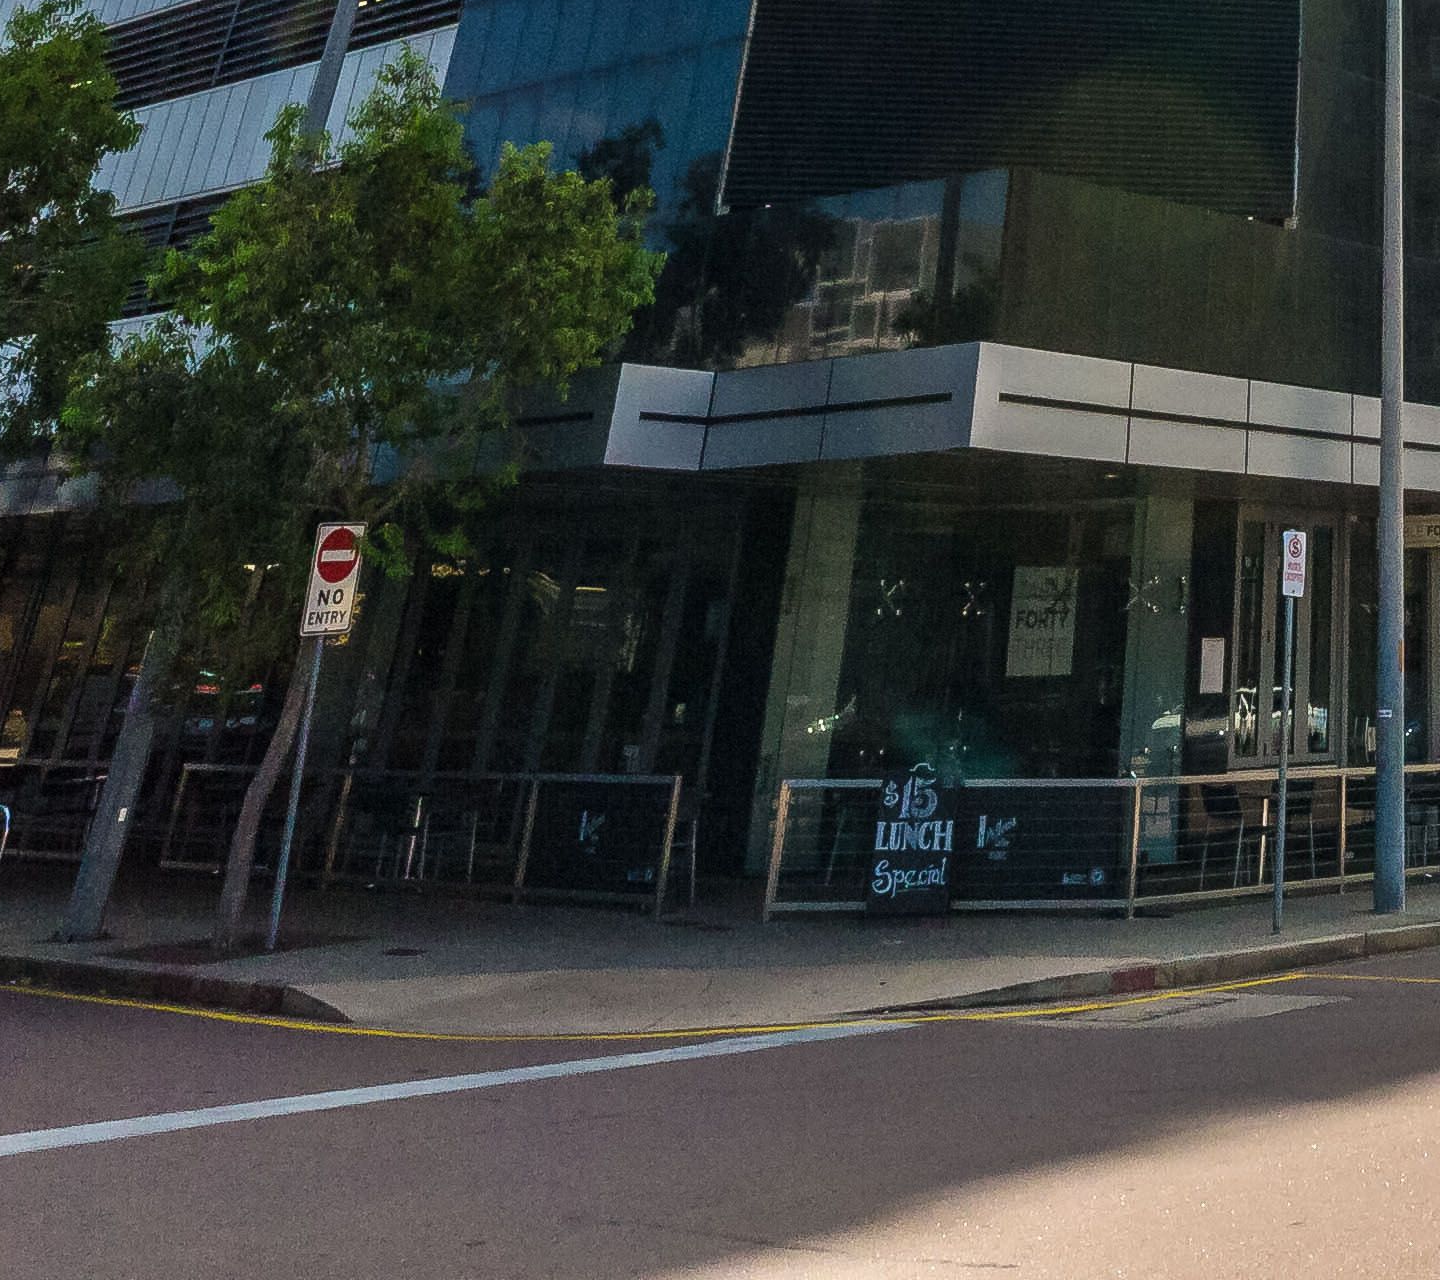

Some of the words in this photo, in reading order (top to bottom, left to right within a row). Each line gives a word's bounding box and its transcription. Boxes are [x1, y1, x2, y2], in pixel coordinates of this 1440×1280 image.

[317, 589, 344, 606] NO
[308, 610, 347, 626] ENTRY
[883, 775, 938, 819] $15
[874, 819, 954, 852] LUNCH
[871, 856, 948, 898] Special
